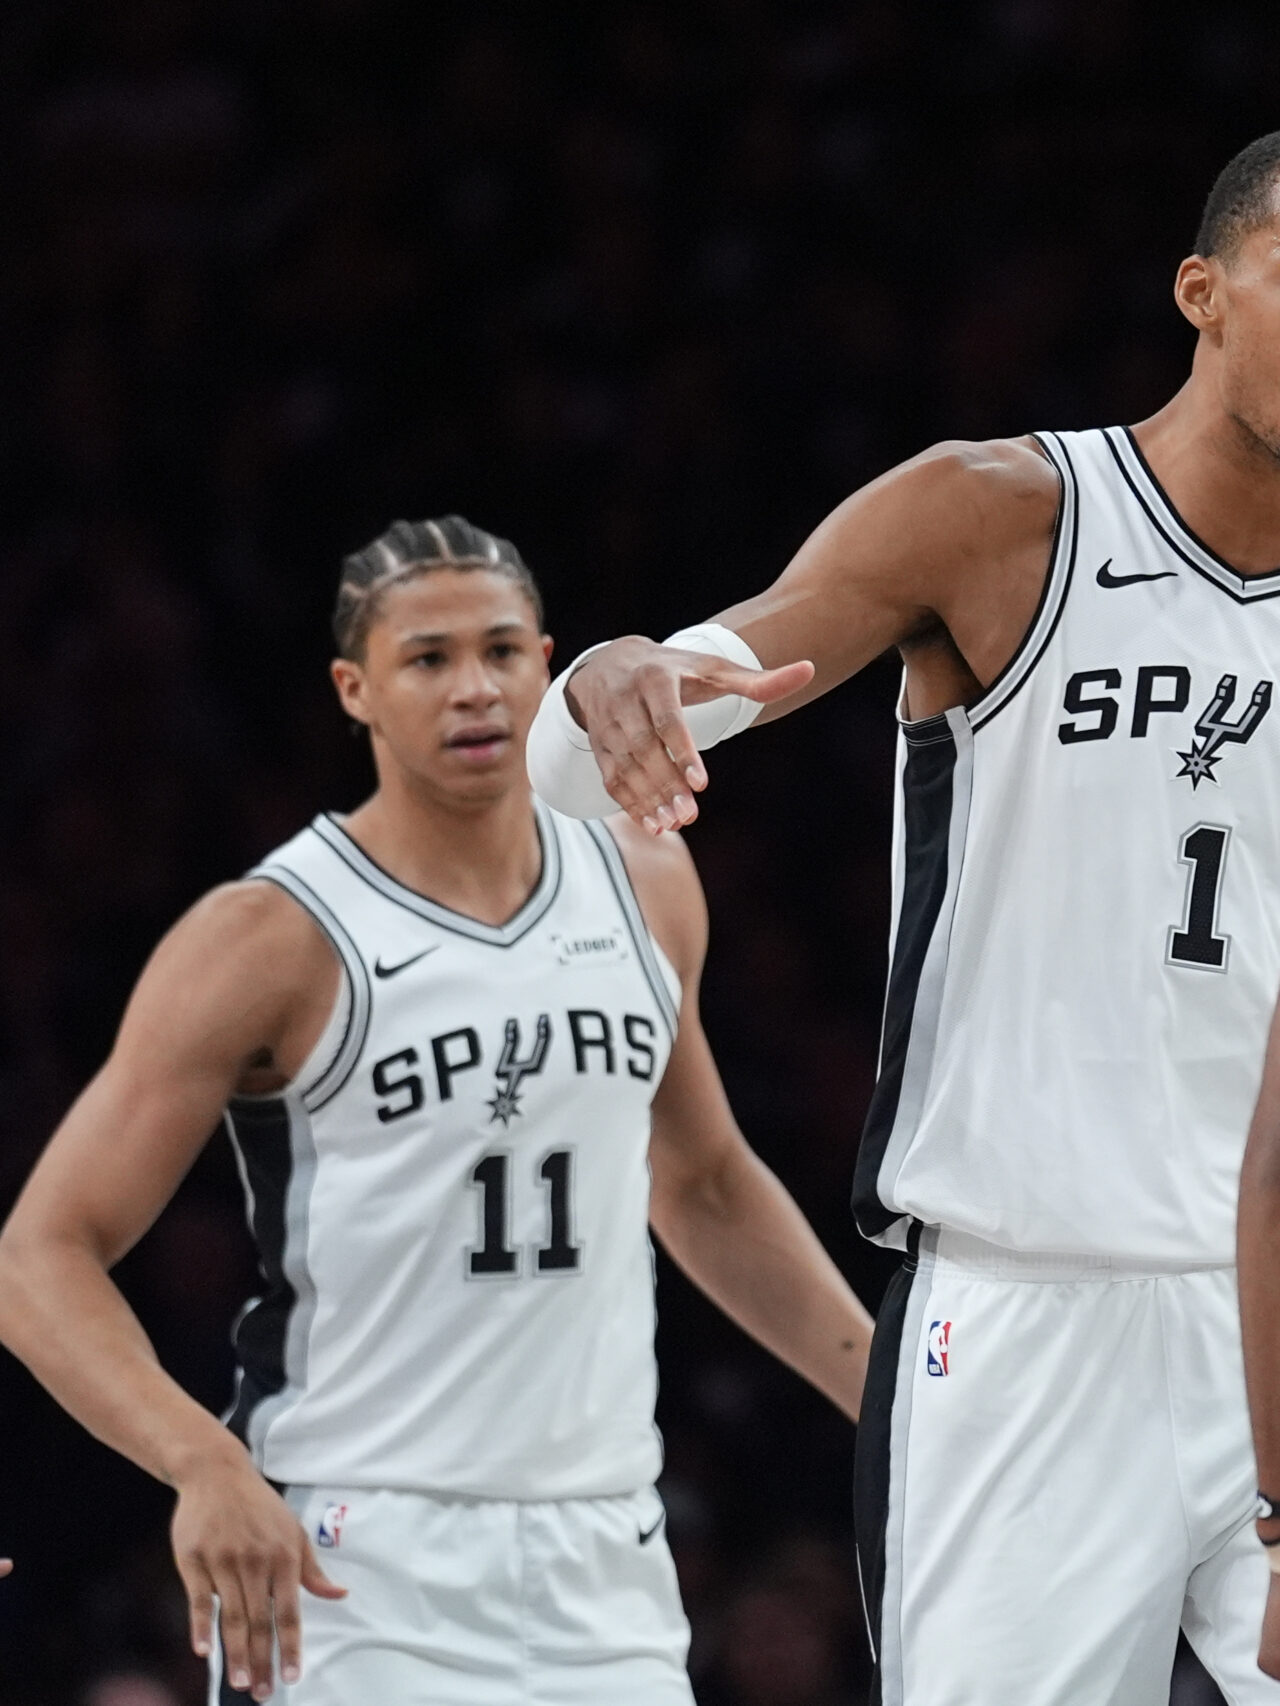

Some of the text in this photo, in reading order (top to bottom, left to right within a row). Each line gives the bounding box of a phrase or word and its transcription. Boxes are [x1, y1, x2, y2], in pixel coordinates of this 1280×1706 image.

[1165, 822, 1232, 974] 1
[372, 1010, 657, 1126] SPURS
[465, 1146, 583, 1281] 11
